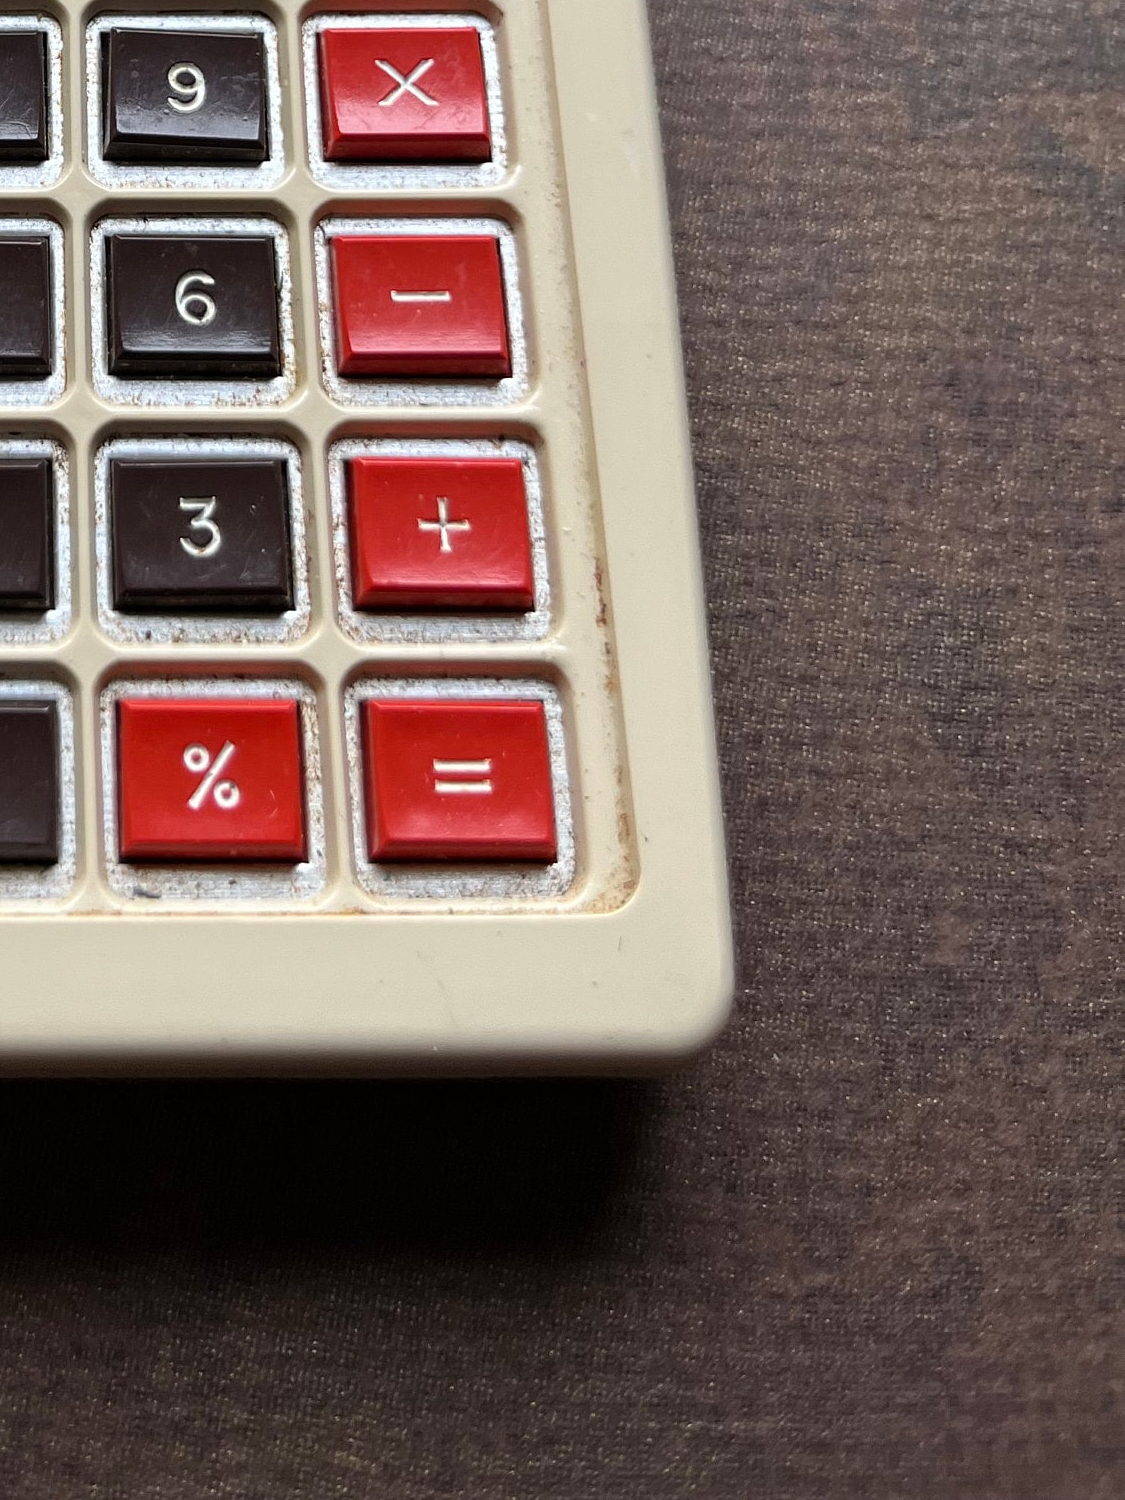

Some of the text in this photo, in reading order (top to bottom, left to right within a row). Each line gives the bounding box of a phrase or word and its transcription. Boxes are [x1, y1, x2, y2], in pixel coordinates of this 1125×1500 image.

[166, 63, 207, 114] 9
[174, 271, 216, 327] 6
[178, 496, 222, 557] 3
[183, 742, 240, 811] %
[433, 758, 491, 796] =
